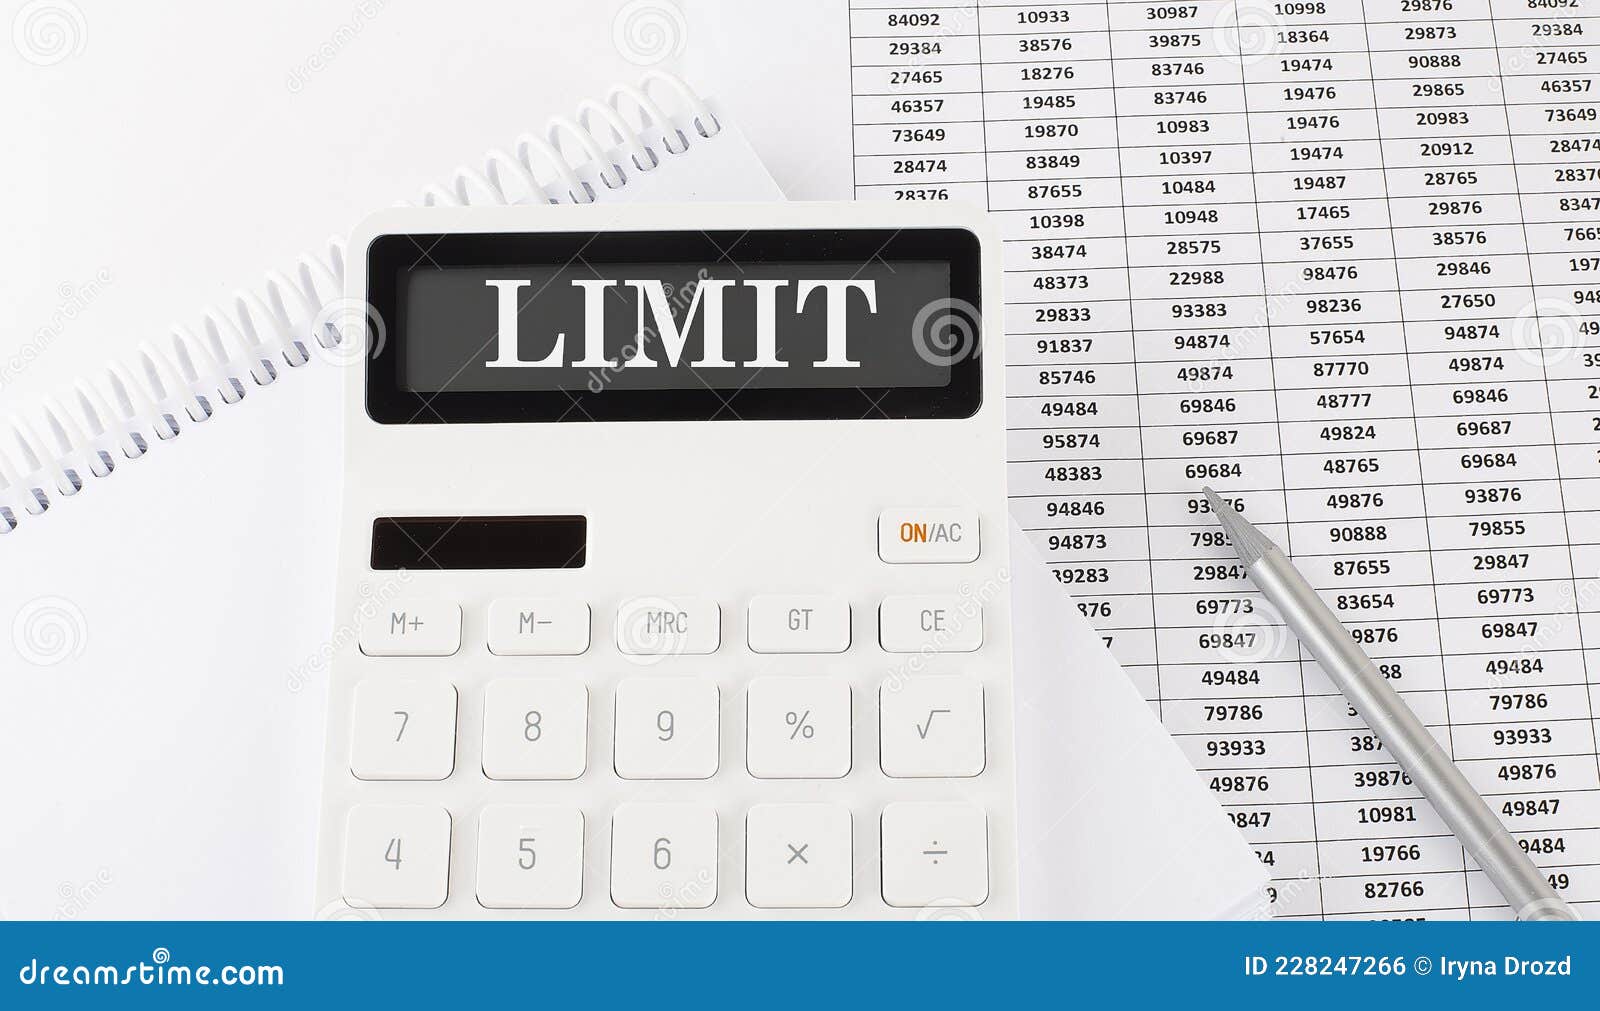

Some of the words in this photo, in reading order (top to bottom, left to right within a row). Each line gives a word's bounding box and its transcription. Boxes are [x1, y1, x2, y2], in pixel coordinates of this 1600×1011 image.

[887, 13, 941, 27] 84092
[1017, 9, 1070, 24] 10933
[1145, 5, 1199, 20] 30987
[1273, 1, 1327, 16] 10998
[1400, 0, 1453, 12] 29876
[888, 41, 943, 56] 29384
[1018, 37, 1073, 53] 38576
[1148, 34, 1202, 48] 39875
[1277, 29, 1330, 44] 18364
[1404, 26, 1457, 41] 29873
[1531, 23, 1584, 37] 29384
[890, 70, 943, 85] 27465
[1020, 66, 1075, 81] 18276
[1151, 62, 1205, 77] 83746
[1280, 58, 1334, 73] 19474
[1408, 54, 1462, 69] 90888
[1535, 51, 1588, 65] 27465
[890, 99, 945, 114] 46357
[1022, 95, 1076, 110] 19485
[1153, 90, 1208, 105] 83746
[1283, 86, 1337, 101] 19476
[1411, 82, 1465, 97] 29865
[1540, 79, 1592, 93] 46357
[891, 128, 946, 143] 73649
[1024, 123, 1079, 139] 19870
[1156, 119, 1210, 134] 10983
[1286, 115, 1340, 130] 19476
[1415, 111, 1470, 126] 20983
[1544, 107, 1597, 123] 73649
[893, 159, 948, 174] 28474
[1025, 154, 1081, 170] 83849
[1159, 150, 1213, 165] 10397
[1289, 146, 1344, 161] 19474
[1419, 142, 1475, 157] 20912
[1027, 184, 1083, 200] 87655
[1161, 179, 1217, 195] 10484
[1293, 175, 1347, 191] 19487
[1424, 171, 1478, 186] 28765
[1029, 213, 1085, 230] 10398
[1164, 209, 1219, 225] 10948
[1296, 205, 1351, 221] 17465
[1427, 200, 1483, 216] 29876
[1559, 197, 1600, 212] 8347
[1031, 244, 1088, 260] 38474
[1166, 239, 1222, 255] 28575
[1299, 235, 1354, 251] 37655
[1431, 230, 1487, 246] 38576
[1032, 275, 1089, 291] 48373
[1168, 270, 1225, 286] 22988
[1302, 265, 1358, 281] 98476
[1436, 261, 1492, 277] 29846
[1568, 257, 1600, 272] 197
[1035, 307, 1092, 323] 29833
[1171, 302, 1228, 319] 93383
[1306, 298, 1362, 314] 98236
[1440, 293, 1496, 309] 27650
[485, 279, 877, 368] LIMIT
[1036, 338, 1093, 354] 91837
[1174, 334, 1231, 350] 94874
[1309, 329, 1366, 346] 57654
[1443, 324, 1501, 341] 94874
[1578, 320, 1600, 336] 49
[1039, 369, 1096, 386] 85746
[1176, 365, 1234, 382] 49874
[1313, 360, 1370, 378] 87770
[1448, 356, 1505, 372] 49874
[1040, 401, 1099, 417] 49484
[1179, 397, 1237, 414] 69846
[1316, 392, 1372, 409] 48777
[1452, 387, 1509, 405] 69846
[1042, 433, 1101, 449] 95874
[1182, 429, 1239, 447] 69687
[1319, 425, 1377, 441] 49824
[1456, 420, 1512, 437] 69687
[1044, 465, 1103, 482] 48383
[1185, 462, 1243, 479] 69684
[1322, 457, 1380, 475] 48765
[1460, 452, 1518, 469] 69684
[1046, 500, 1105, 518] 94846
[1326, 492, 1384, 510] 49876
[1464, 487, 1522, 504] 93876
[900, 522, 962, 544] ON/AC
[1048, 533, 1108, 551] 94873
[1329, 525, 1388, 543] 90888
[1468, 519, 1526, 537] 79855
[1333, 559, 1391, 577] 87655
[1472, 553, 1530, 571] 29847
[1195, 598, 1254, 615] 69773
[1336, 593, 1395, 611] 83654
[1477, 587, 1535, 605] 69773
[390, 612, 425, 635] M+
[646, 611, 688, 634] MRC
[788, 608, 814, 631] GT
[920, 609, 946, 632] CE
[1198, 632, 1256, 649] 69847
[1481, 621, 1538, 639] 69847
[1201, 669, 1261, 686] 49484
[1485, 658, 1545, 676] 49484
[1203, 704, 1264, 722] 79786
[1488, 692, 1548, 711] 79786
[393, 711, 409, 742] 7
[524, 710, 542, 742] 8
[656, 710, 674, 742] 9
[785, 709, 815, 741] %
[1206, 739, 1266, 757] 93933
[1493, 727, 1553, 746] 93933
[1209, 775, 1269, 793] 49876
[1497, 763, 1557, 782] 49876
[1357, 805, 1417, 824] 10981
[1501, 798, 1560, 817] 49847
[384, 838, 403, 871] 4
[518, 837, 536, 871] 5
[653, 837, 672, 870] 6
[1361, 844, 1421, 863] 19766
[1517, 837, 1567, 855] 9484
[1364, 880, 1425, 899] 82766
[1547, 873, 1570, 890] 49
